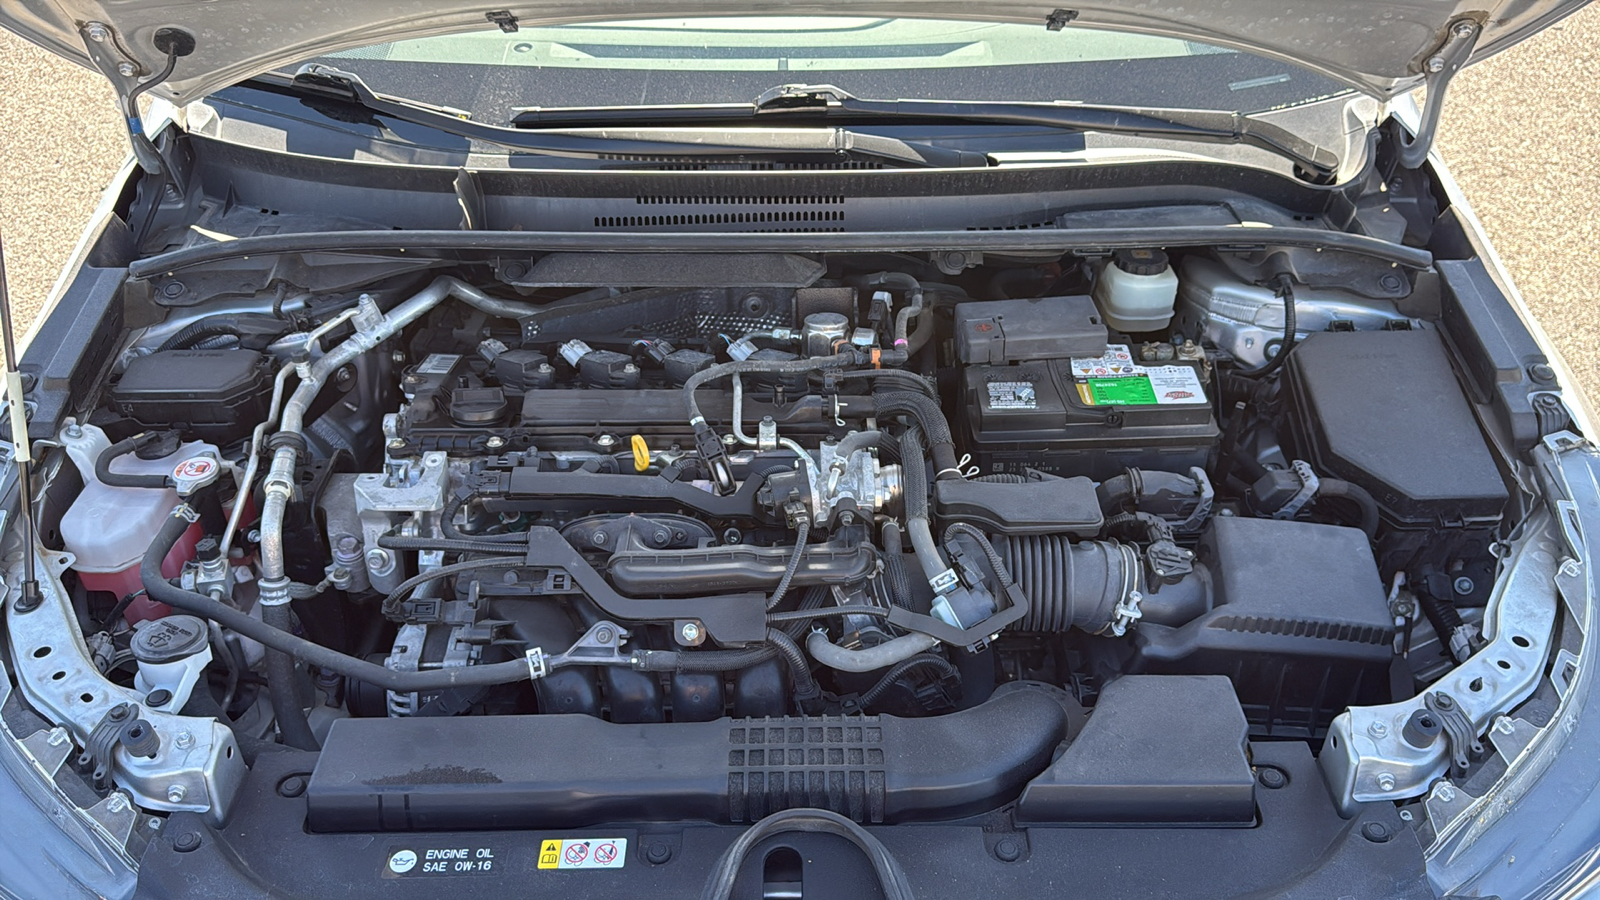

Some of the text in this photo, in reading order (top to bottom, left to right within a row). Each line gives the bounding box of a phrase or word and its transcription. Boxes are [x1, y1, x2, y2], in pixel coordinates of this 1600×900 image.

[425, 848, 494, 860] ENGINE OIL
[422, 860, 492, 872] SAE 0W-16
